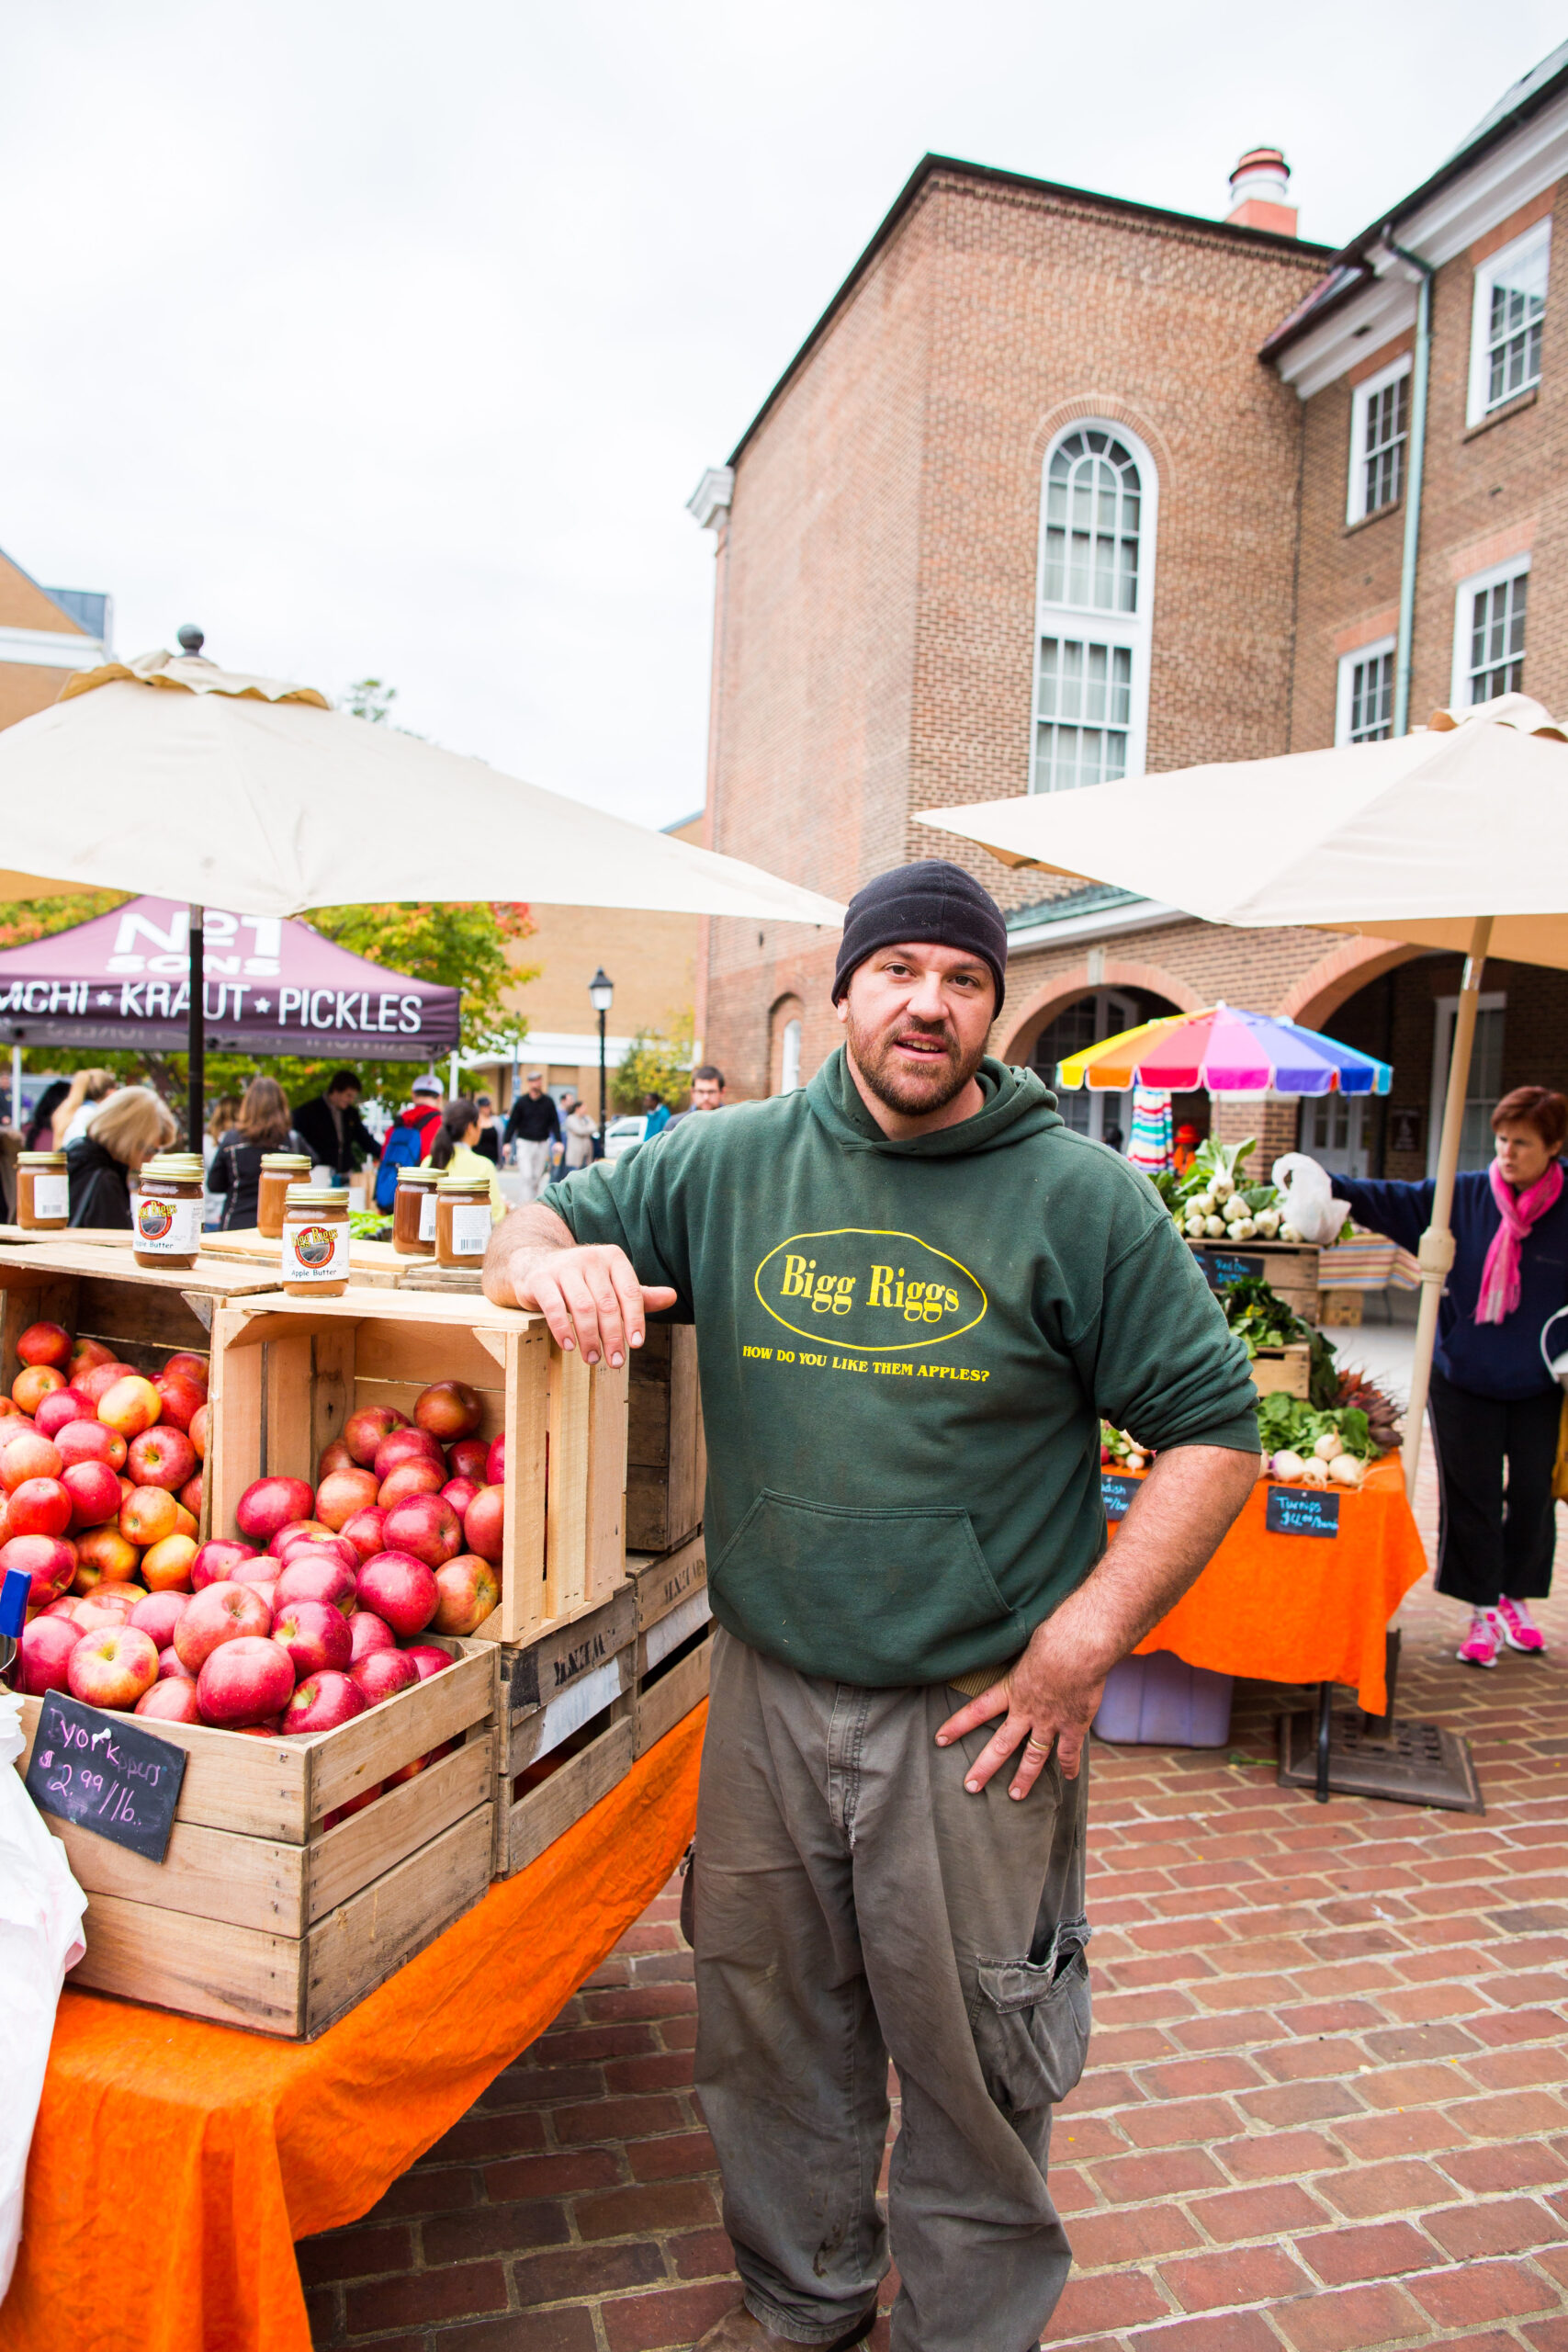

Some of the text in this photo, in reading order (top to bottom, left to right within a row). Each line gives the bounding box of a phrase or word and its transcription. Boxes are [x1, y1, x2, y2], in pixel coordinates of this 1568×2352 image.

[105, 954, 281, 977] SONS
[120, 980, 252, 1022] KRAUT
[278, 987, 423, 1034] PICKLES
[151, 1200, 177, 1219] Riggs
[149, 1240, 175, 1249] Butter
[311, 1227, 338, 1244] Riggs
[291, 1270, 310, 1278] Apple
[780, 1254, 959, 1323] Bigg Riggs
[742, 1345, 990, 1382] HOW DO YOU LIKE THEM APPLES?
[1274, 1496, 1322, 1514] Turnips
